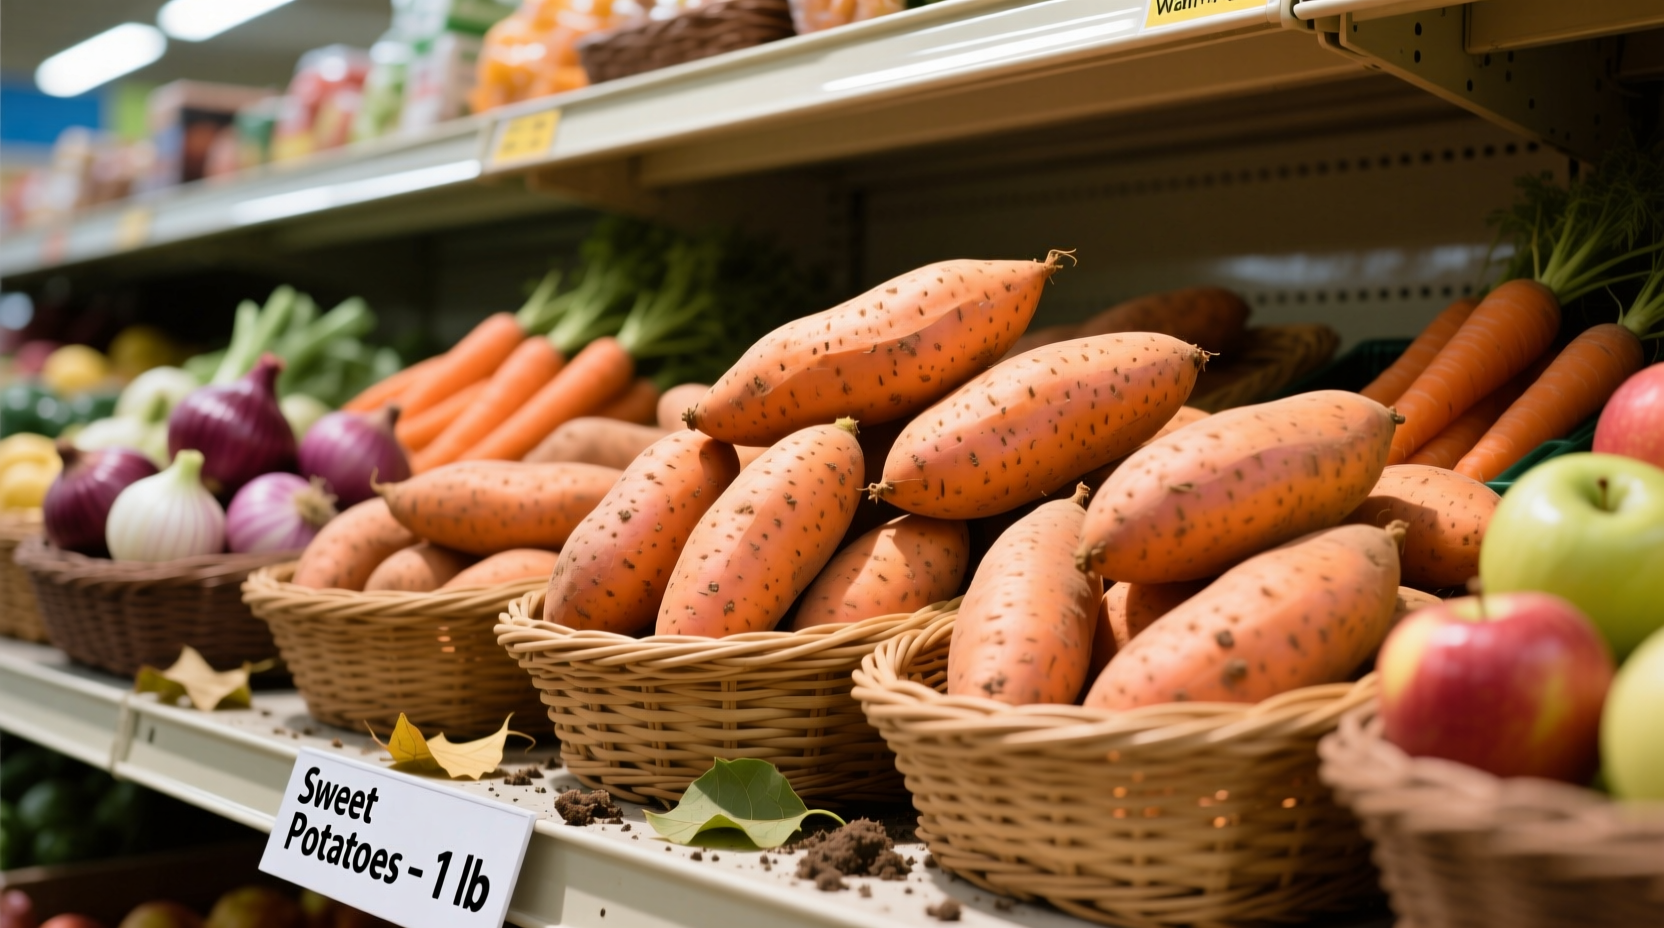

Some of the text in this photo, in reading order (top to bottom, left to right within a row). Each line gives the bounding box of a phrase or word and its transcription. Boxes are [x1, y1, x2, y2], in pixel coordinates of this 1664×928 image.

[297, 766, 379, 824] Sweet
[283, 811, 403, 885] Potatoes
[431, 850, 453, 900] 1
[452, 854, 490, 913] lb
